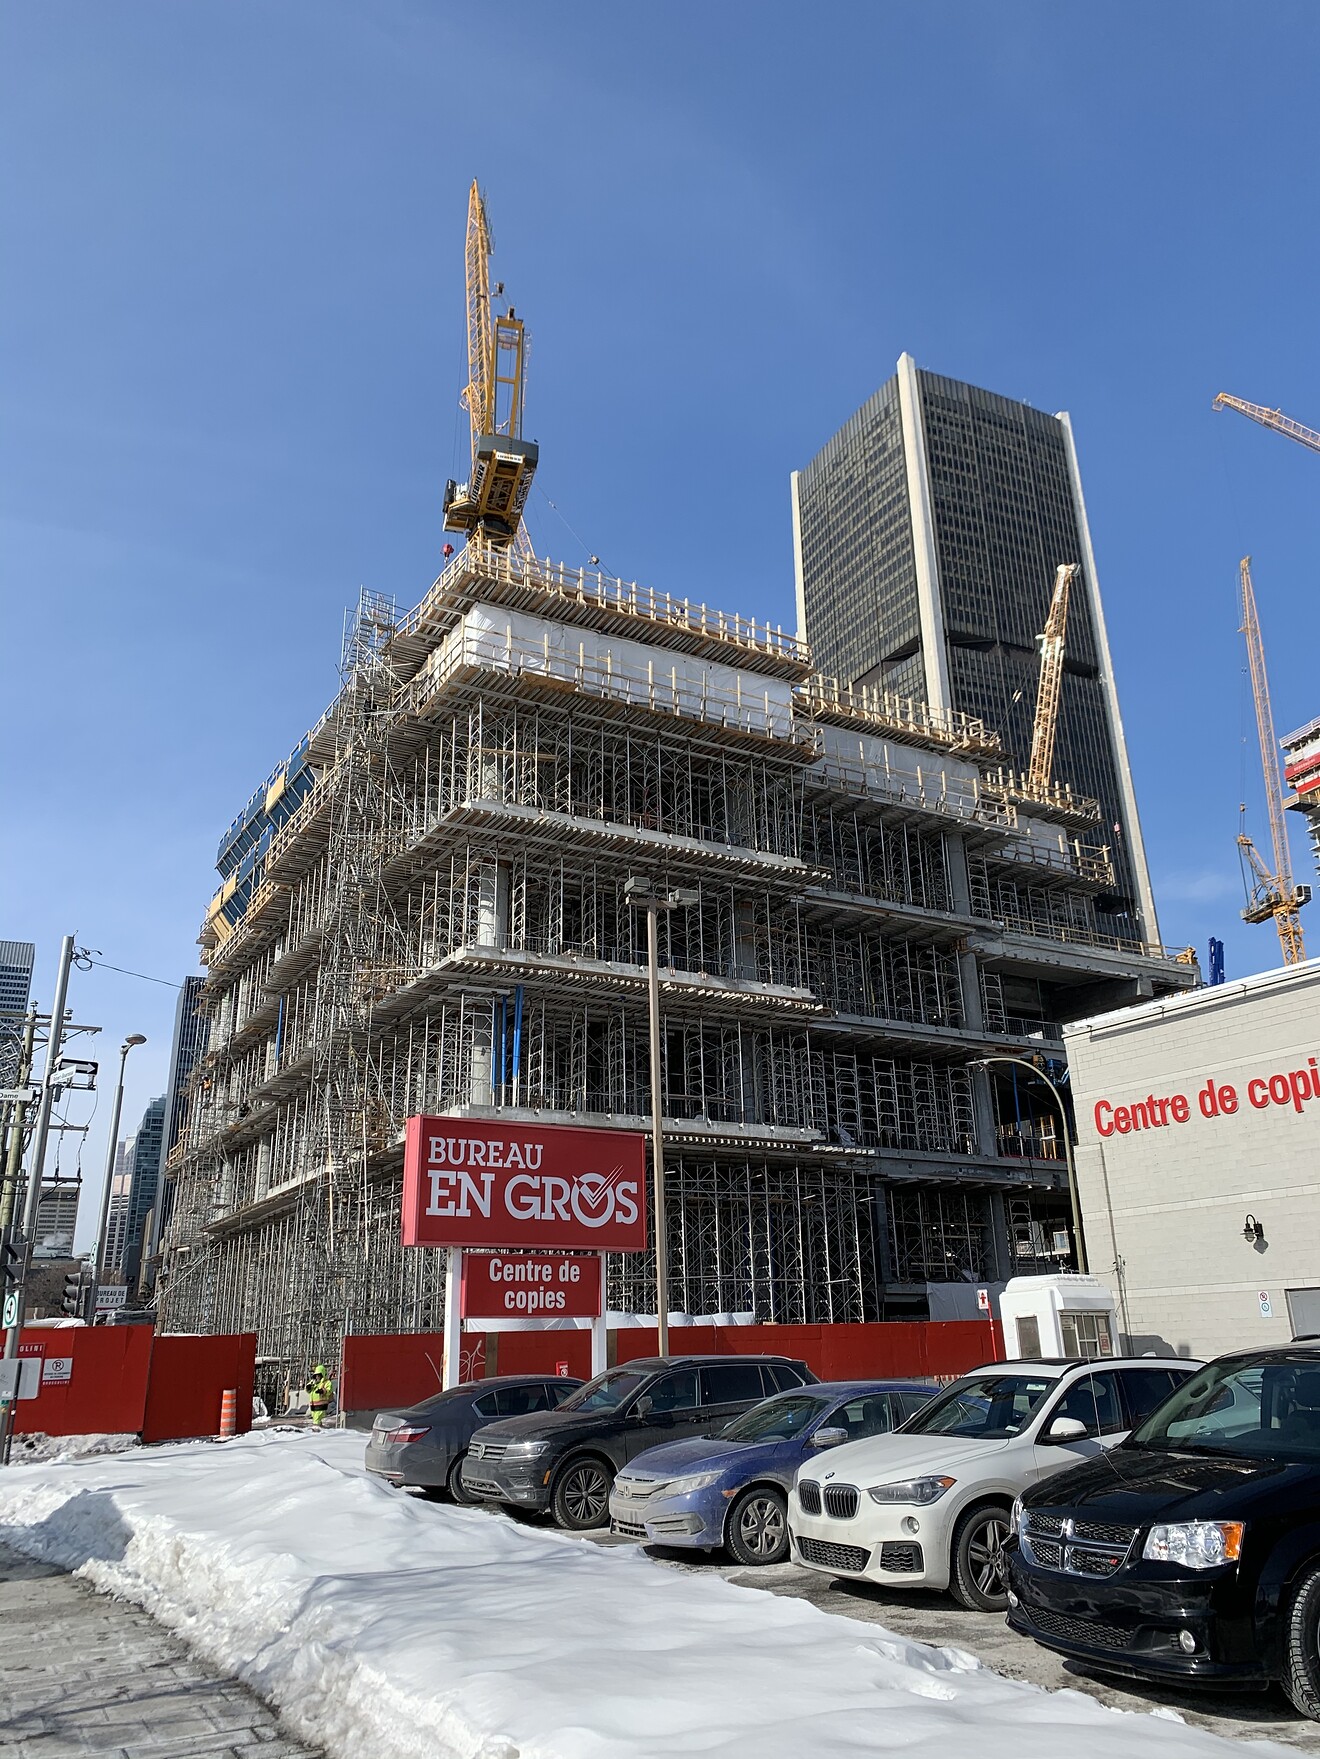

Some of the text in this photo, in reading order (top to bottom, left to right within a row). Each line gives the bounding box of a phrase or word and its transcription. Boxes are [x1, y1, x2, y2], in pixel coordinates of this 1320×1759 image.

[1094, 1057, 1320, 1137] Centre de copi
[428, 1136, 544, 1170] BUREAU
[425, 1169, 639, 1228] EN GROS
[489, 1258, 581, 1283] Centre de
[504, 1286, 566, 1314] copies
